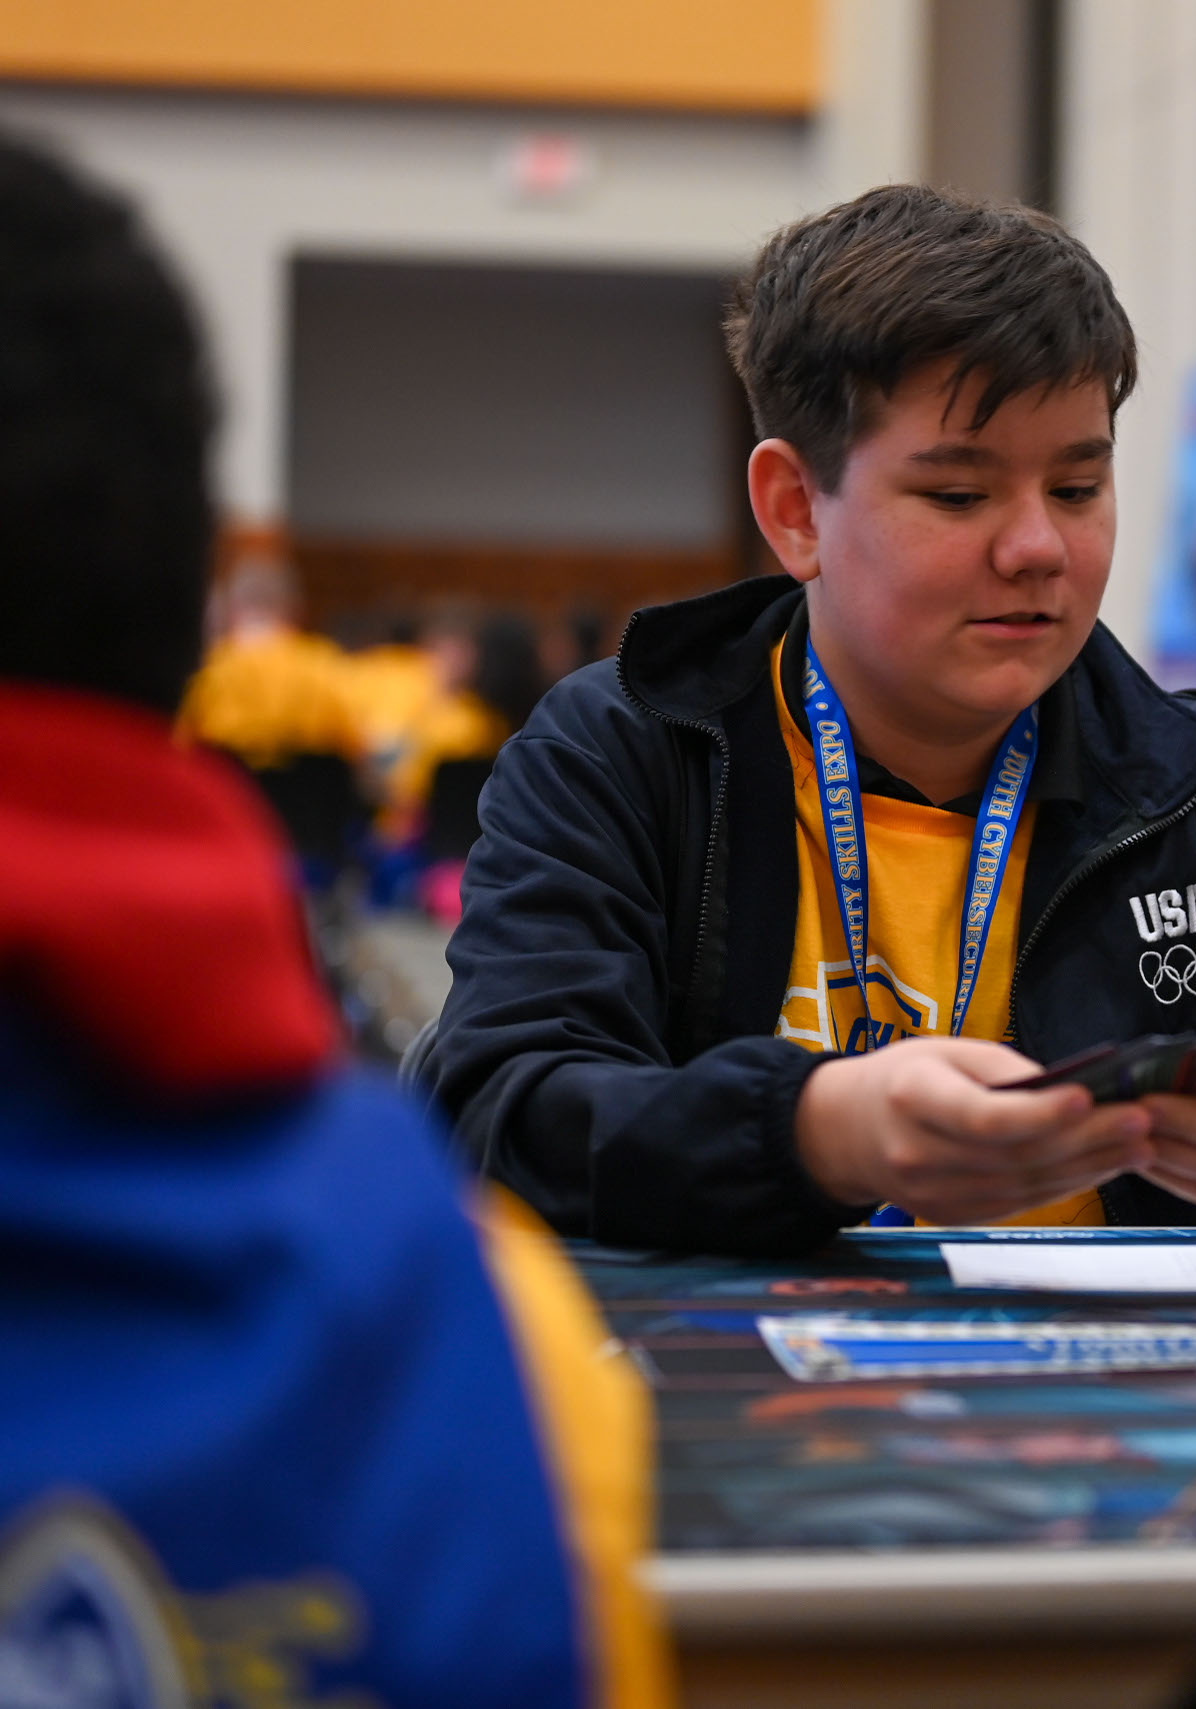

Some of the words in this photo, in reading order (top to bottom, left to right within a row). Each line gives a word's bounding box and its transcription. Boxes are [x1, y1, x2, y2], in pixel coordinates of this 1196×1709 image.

[817, 720, 849, 784] EXPO
[987, 745, 1030, 820] YOUTH
[827, 786, 861, 880] SKILLS
[841, 884, 866, 992] CURITY
